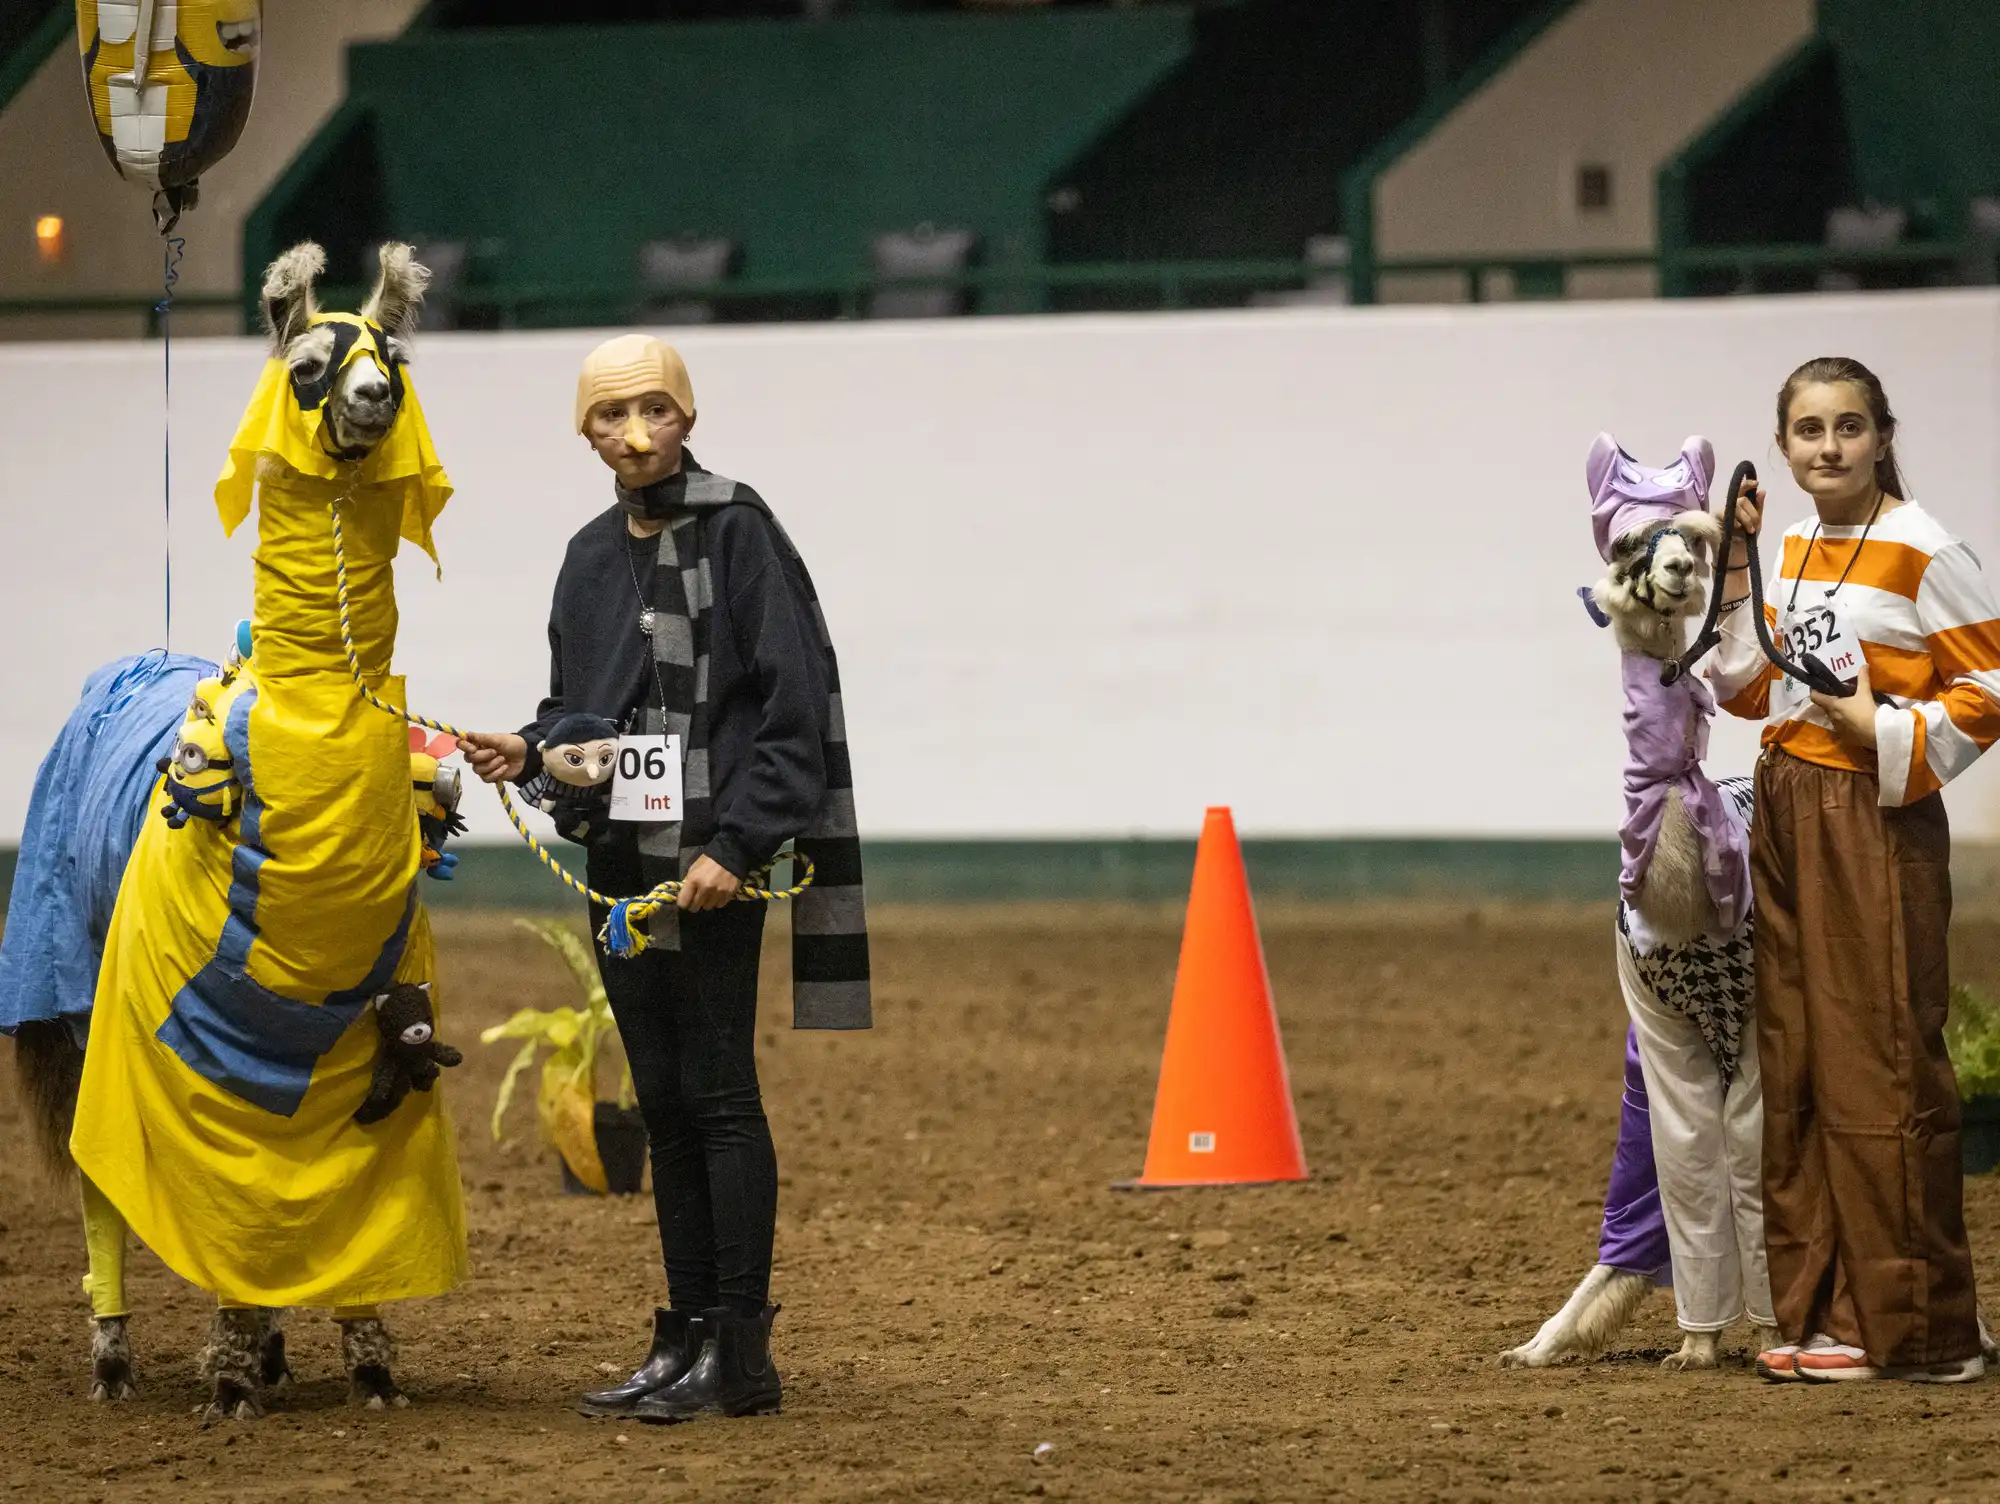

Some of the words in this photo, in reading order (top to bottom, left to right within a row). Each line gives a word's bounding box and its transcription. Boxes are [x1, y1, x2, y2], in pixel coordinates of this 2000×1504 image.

[1783, 609, 1841, 663] 4352
[1830, 651, 1855, 672] Int
[619, 747, 666, 780] 06
[644, 794, 670, 810] Int
